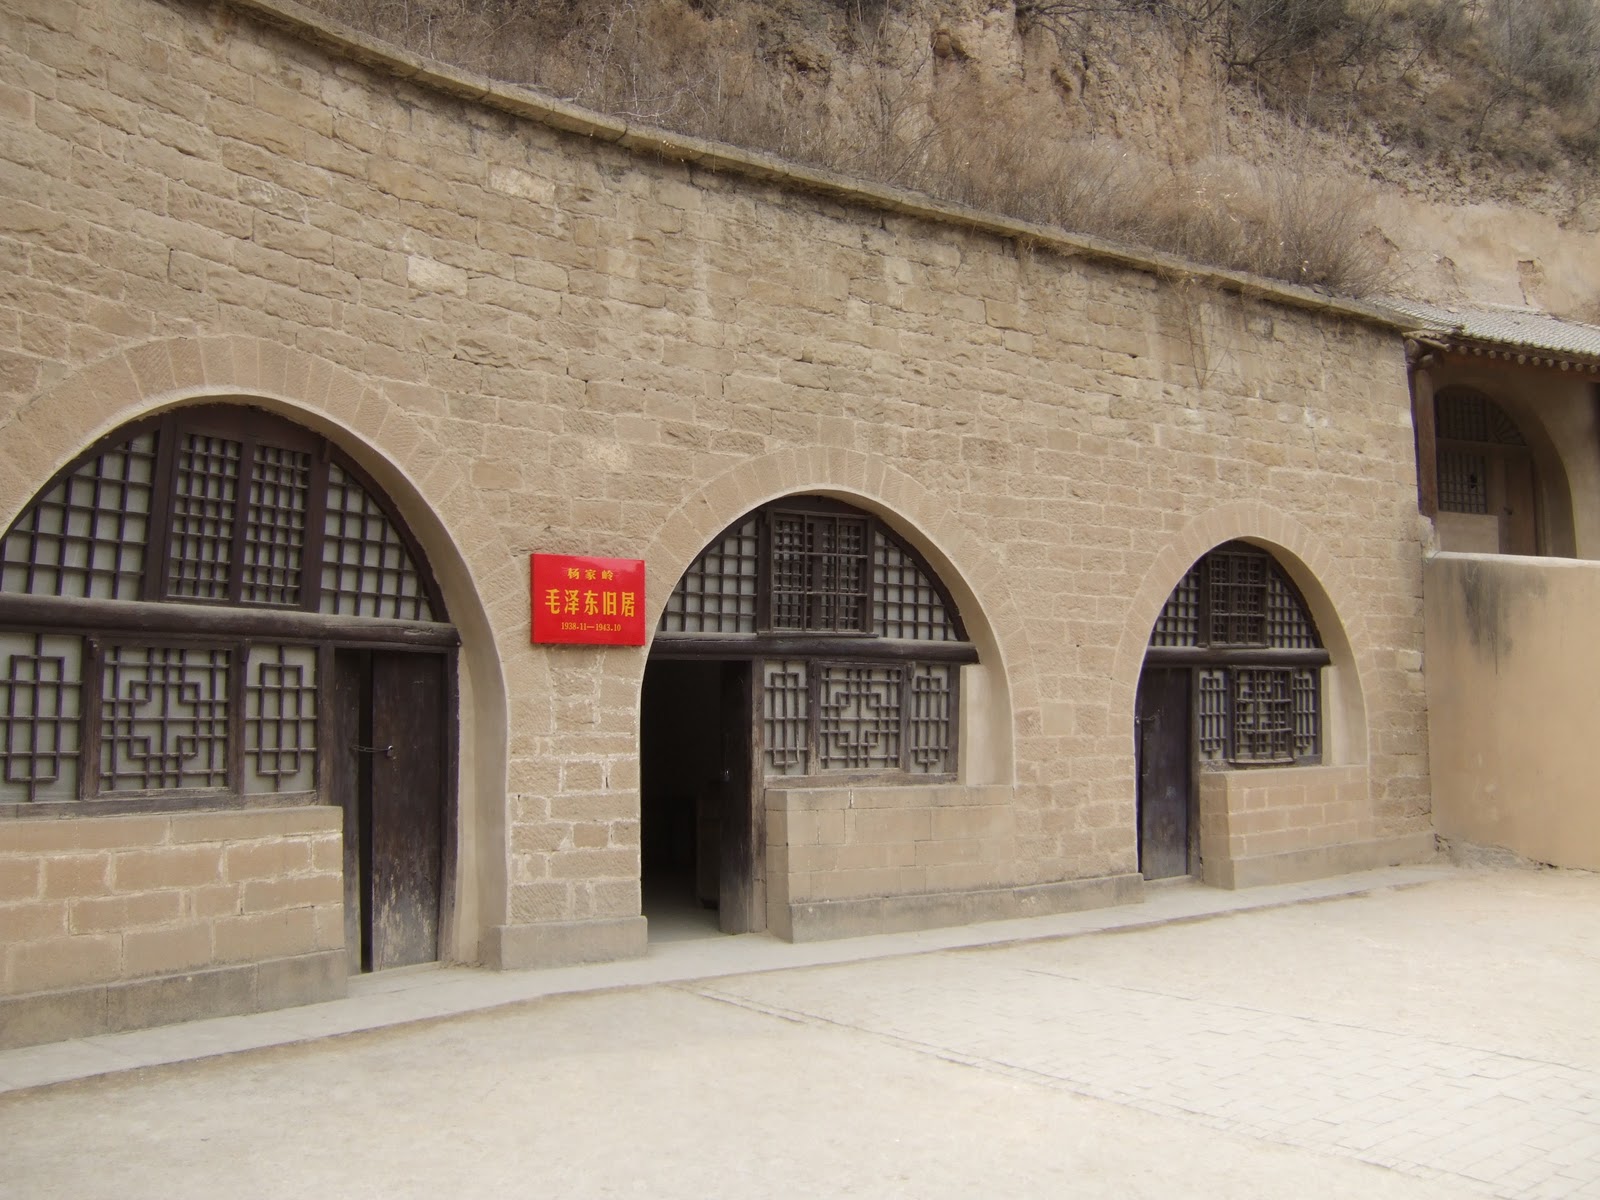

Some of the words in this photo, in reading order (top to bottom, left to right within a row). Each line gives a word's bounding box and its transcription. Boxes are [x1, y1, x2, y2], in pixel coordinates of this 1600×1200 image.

[567, 567, 614, 581] 杨家岭
[544, 588, 635, 617] 毛泽东旧居
